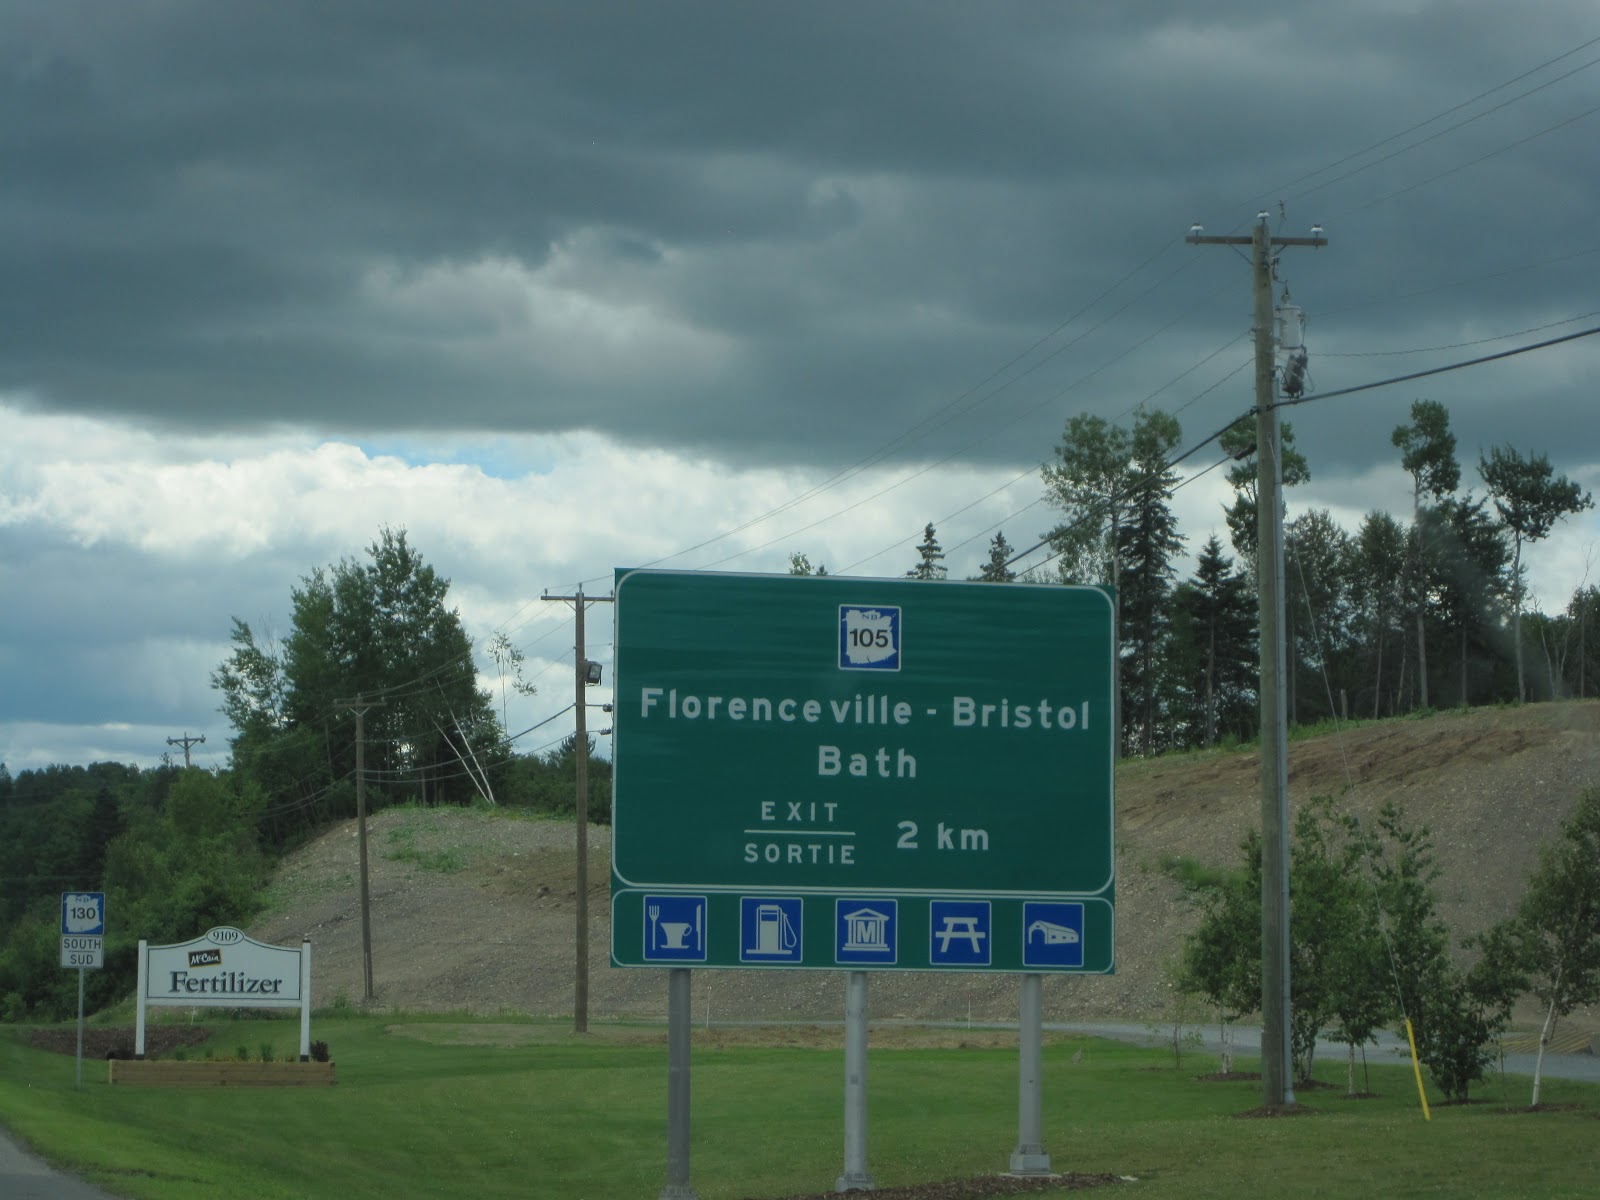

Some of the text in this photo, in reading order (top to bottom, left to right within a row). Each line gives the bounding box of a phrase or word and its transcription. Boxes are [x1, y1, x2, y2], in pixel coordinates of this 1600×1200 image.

[862, 613, 878, 621] NB
[849, 628, 889, 648] 105
[641, 687, 912, 724] Florenceville
[953, 696, 1089, 729] Bristol
[818, 745, 916, 778] Bath
[761, 801, 838, 822] EXIT
[897, 820, 989, 850] 2 km
[744, 843, 856, 864] SORTIE
[70, 907, 96, 920] 130
[63, 938, 101, 950] SOUTH
[212, 931, 238, 941] 9109
[70, 953, 94, 965] SUD
[190, 952, 220, 965] McCain
[167, 970, 283, 995] Fertilizer
